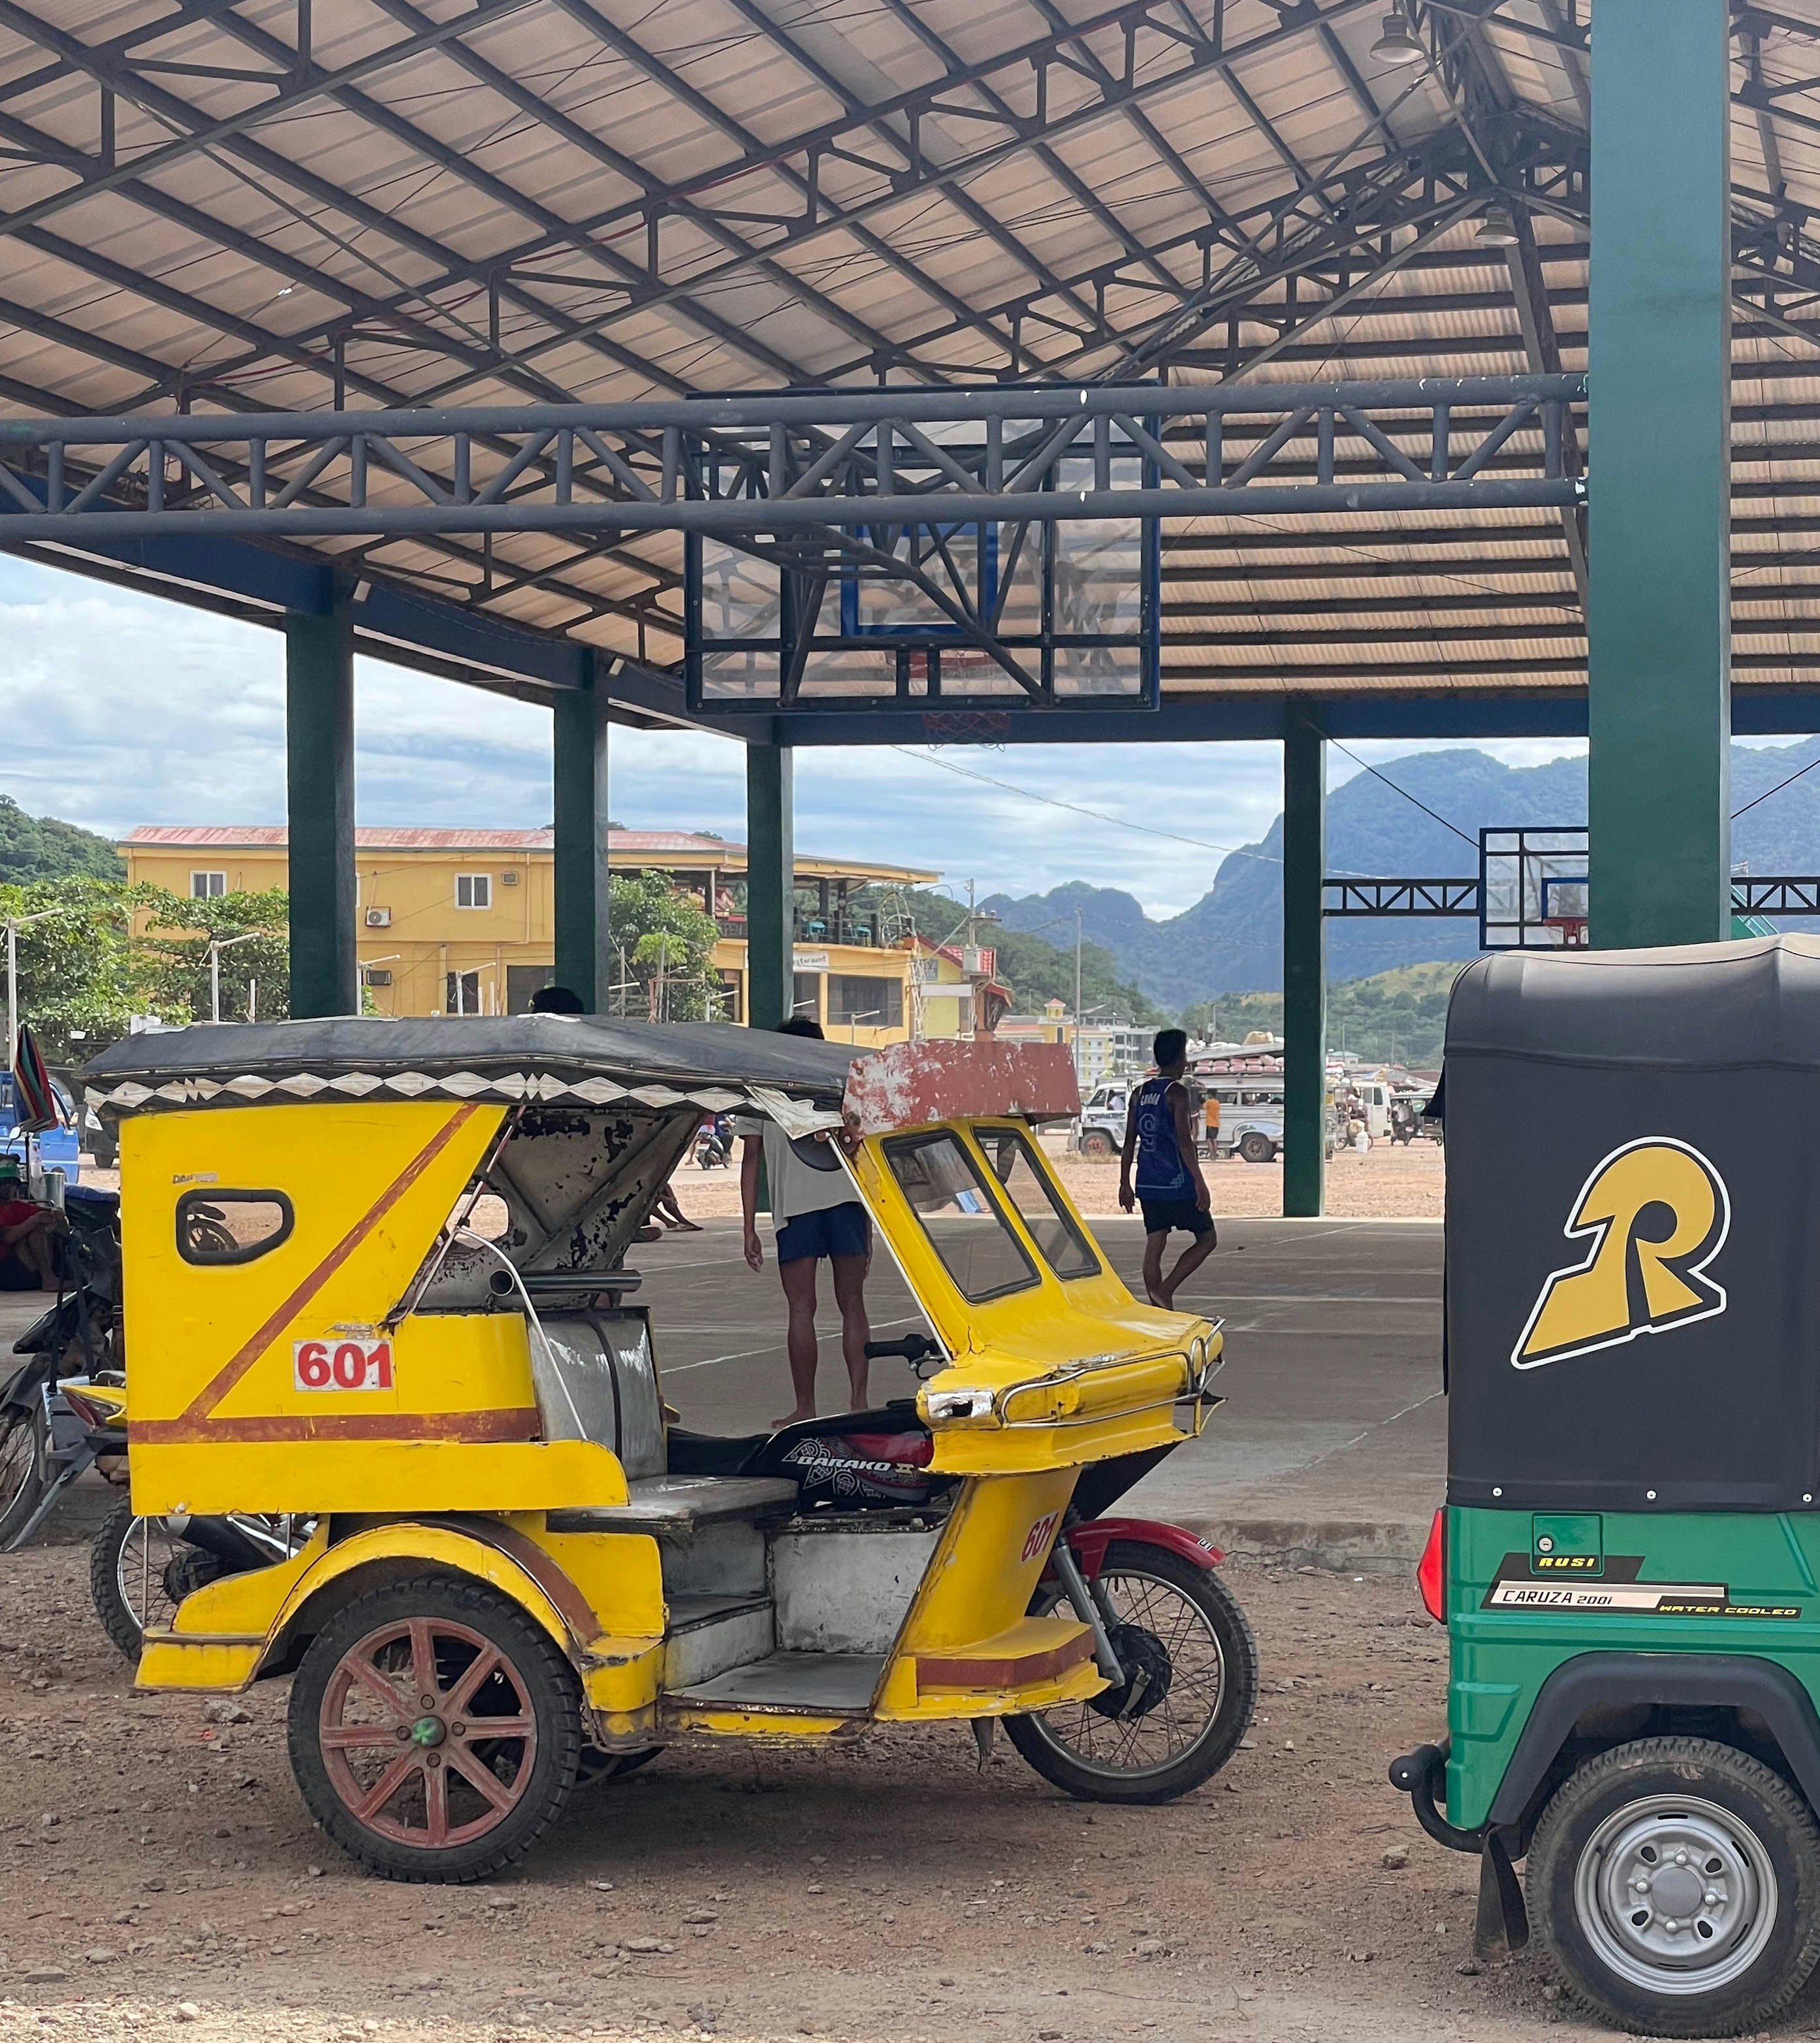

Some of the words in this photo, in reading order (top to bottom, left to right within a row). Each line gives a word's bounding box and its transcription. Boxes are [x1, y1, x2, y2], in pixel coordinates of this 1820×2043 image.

[298, 1343, 392, 1388] 601
[797, 1456, 891, 1472] BARAKO
[1021, 1511, 1059, 1562] 601
[1538, 1557, 1595, 1568] RUSI
[1503, 1590, 1573, 1603] CARUZA
[1659, 1605, 1721, 1613] WATER
[1724, 1607, 1797, 1616] COOLED
